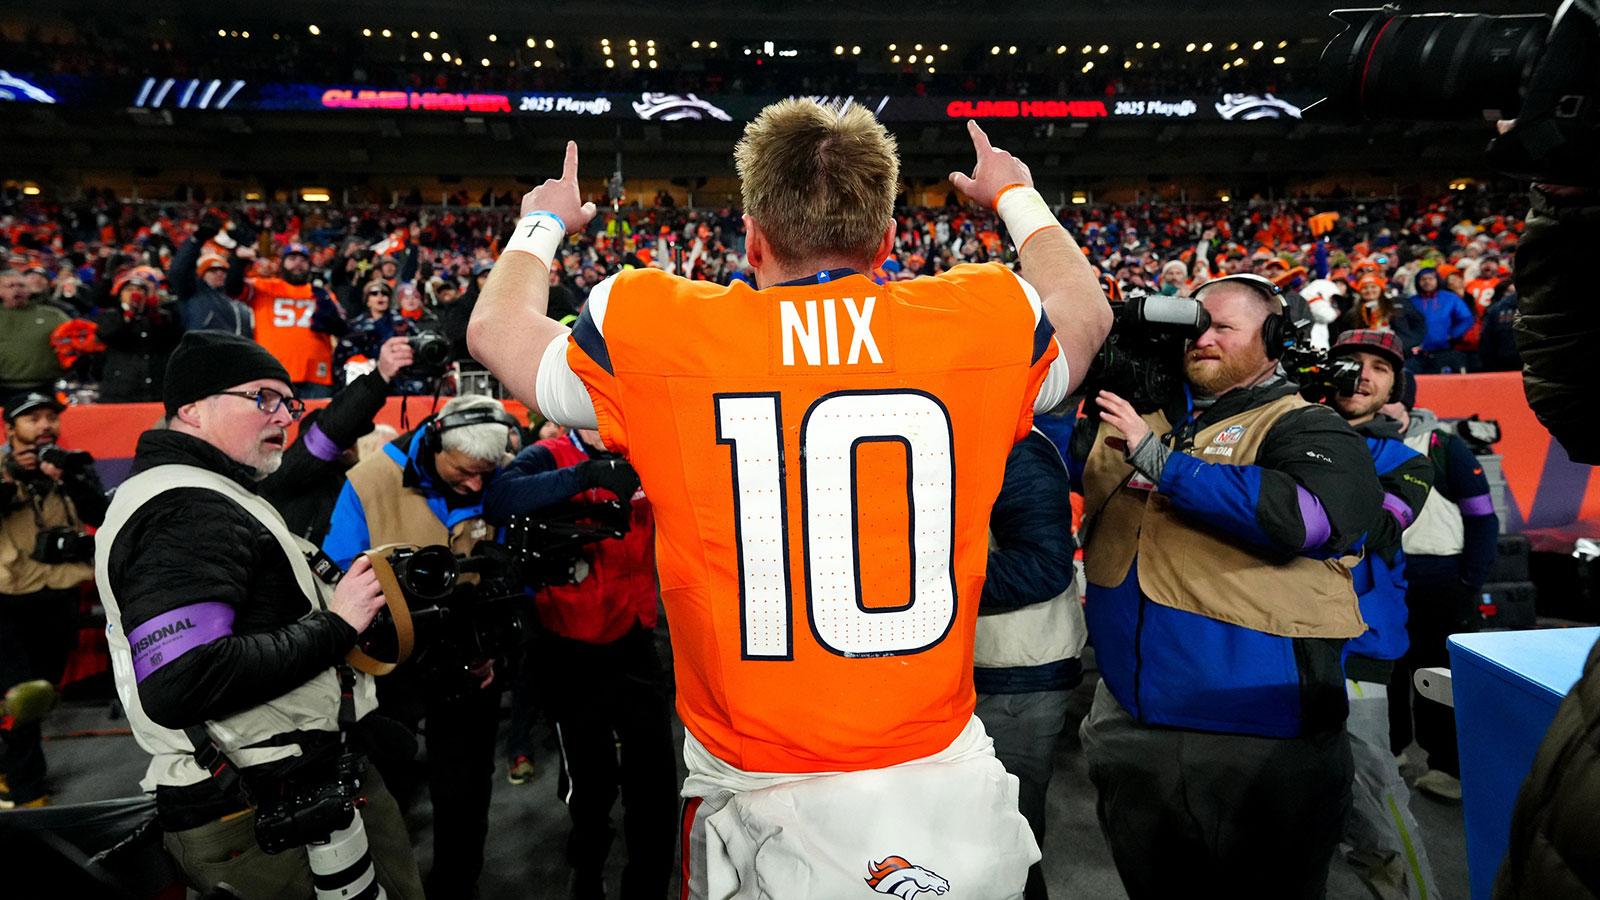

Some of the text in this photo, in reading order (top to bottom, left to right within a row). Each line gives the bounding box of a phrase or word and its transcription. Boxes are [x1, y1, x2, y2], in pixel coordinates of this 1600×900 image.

[519, 96, 611, 115] 2025 Playoffs
[1114, 100, 1197, 117] 2025 Playoffs
[273, 298, 316, 328] 57
[780, 297, 883, 366] NIX
[1203, 446, 1233, 457] MEDIA
[713, 387, 958, 661] 10
